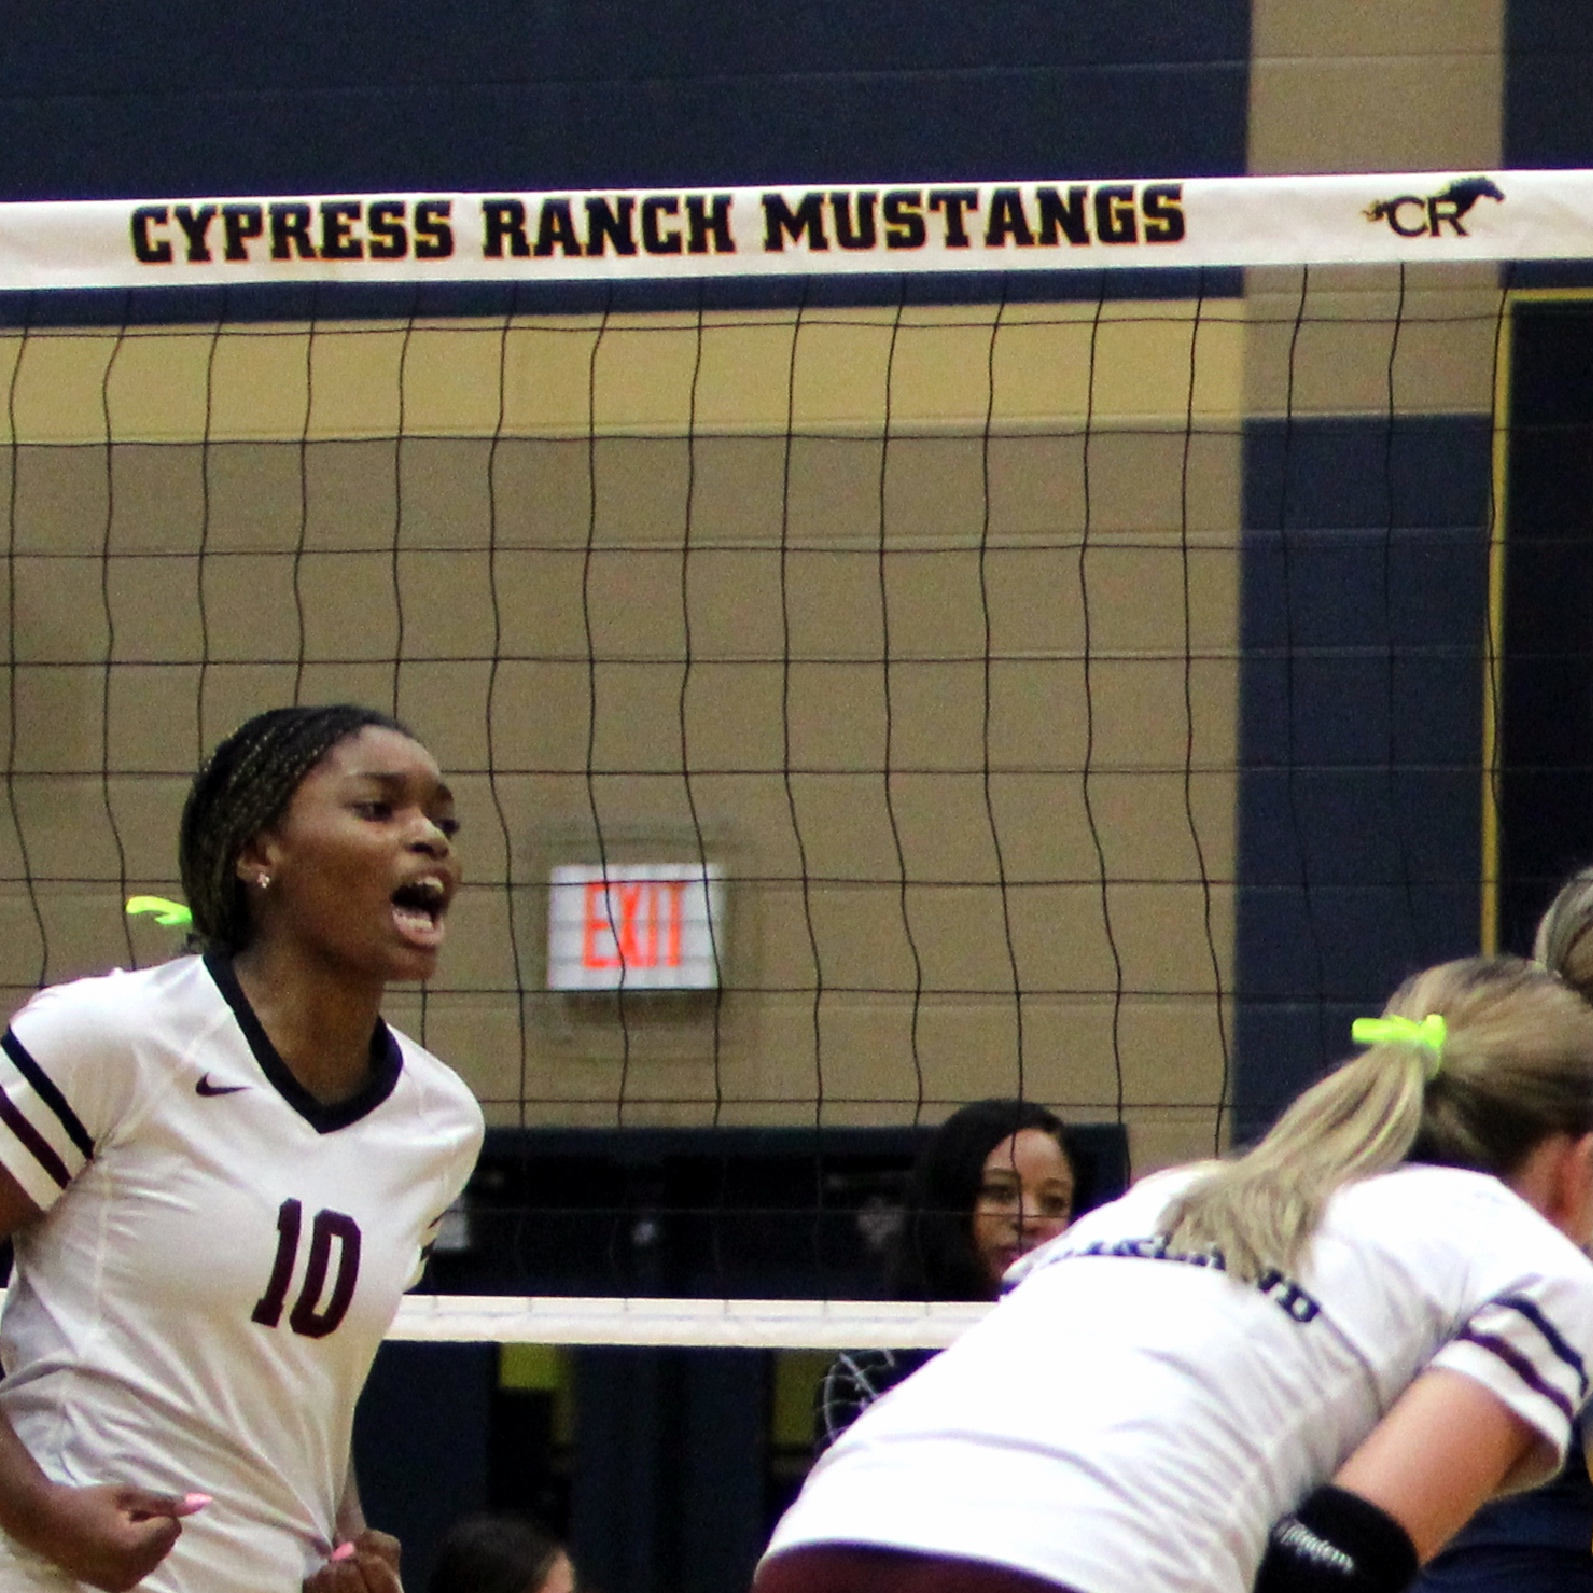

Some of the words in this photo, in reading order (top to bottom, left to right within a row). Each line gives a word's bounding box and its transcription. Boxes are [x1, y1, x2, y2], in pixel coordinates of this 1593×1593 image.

[130, 201, 454, 265] CYPRESS
[482, 194, 737, 259] RANCH
[762, 184, 1188, 254] MUSTANGS
[1386, 197, 1472, 238] CR
[583, 881, 688, 968] EXIT
[251, 1197, 362, 1340] 10
